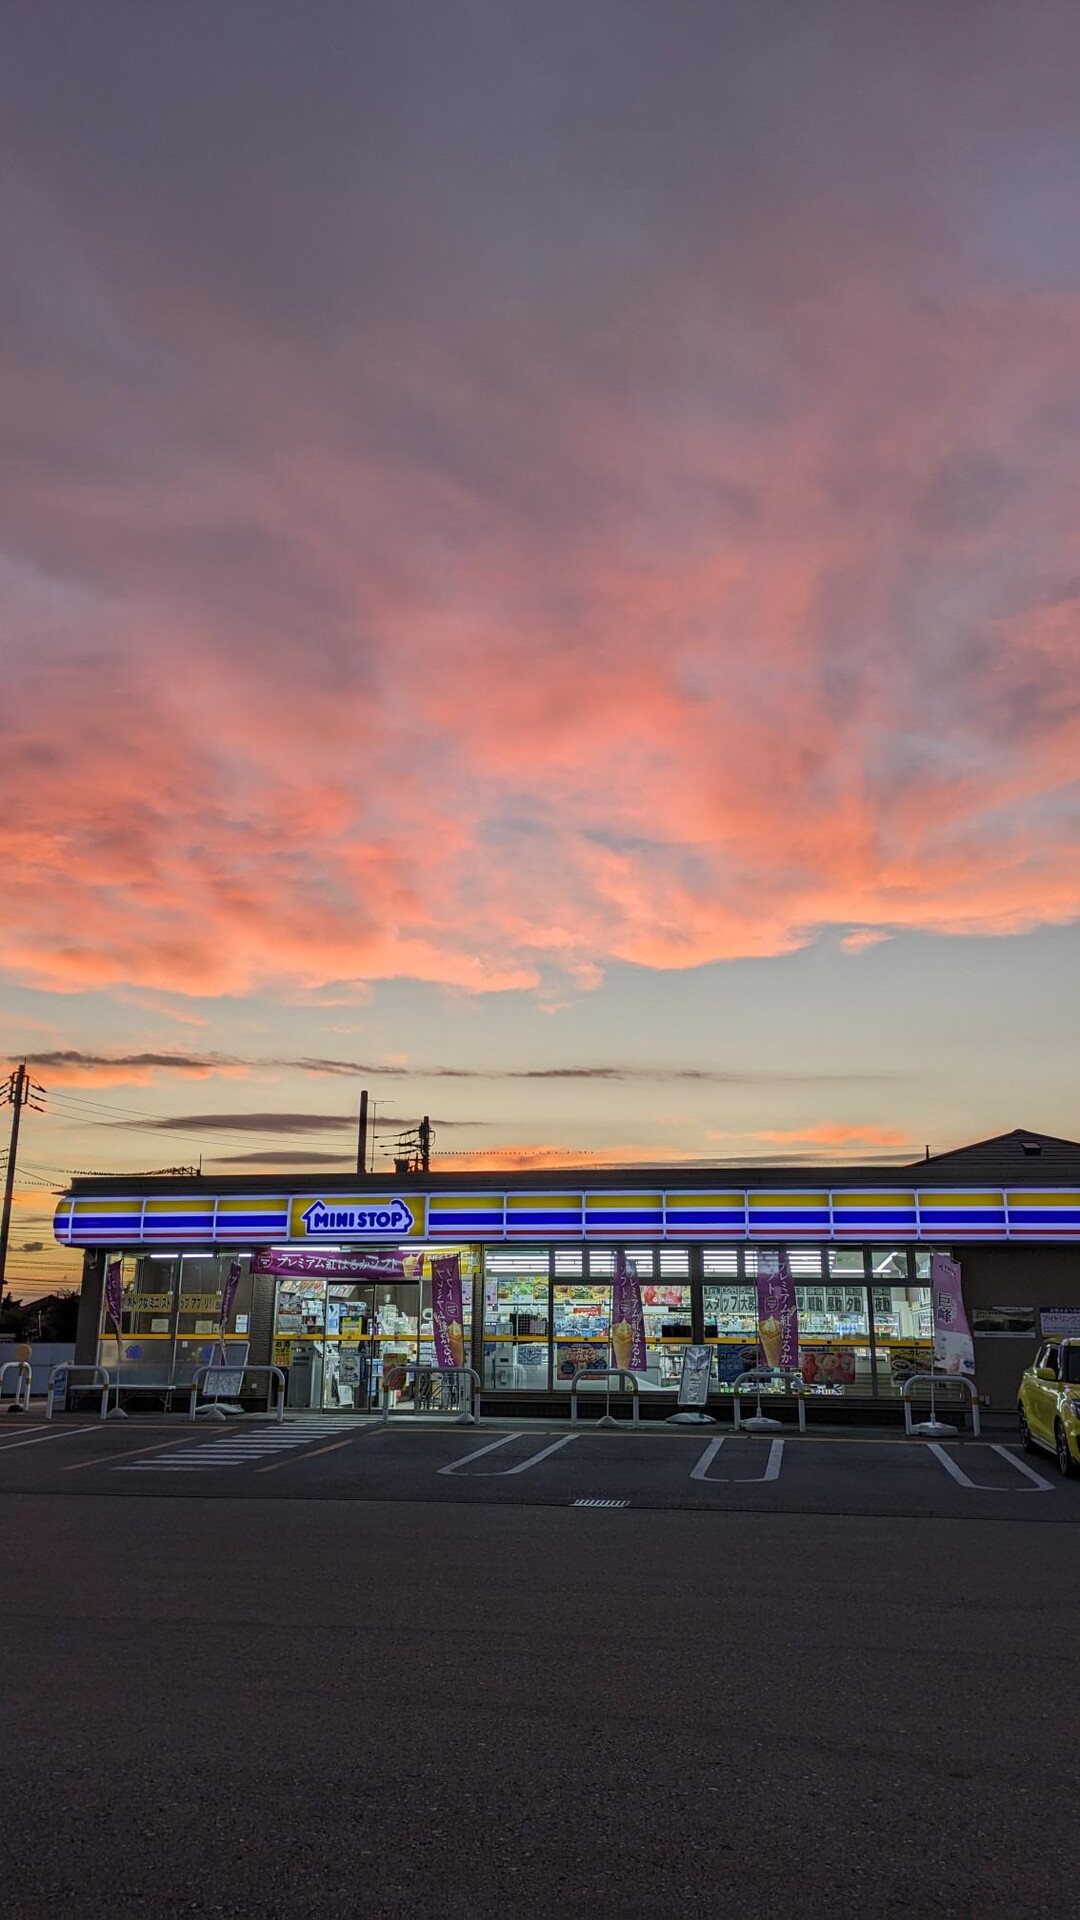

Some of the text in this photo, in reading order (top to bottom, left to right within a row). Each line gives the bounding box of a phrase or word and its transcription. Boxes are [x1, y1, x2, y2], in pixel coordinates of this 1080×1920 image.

[276, 1256, 398, 1270] プレミアム紅はるかソフト
